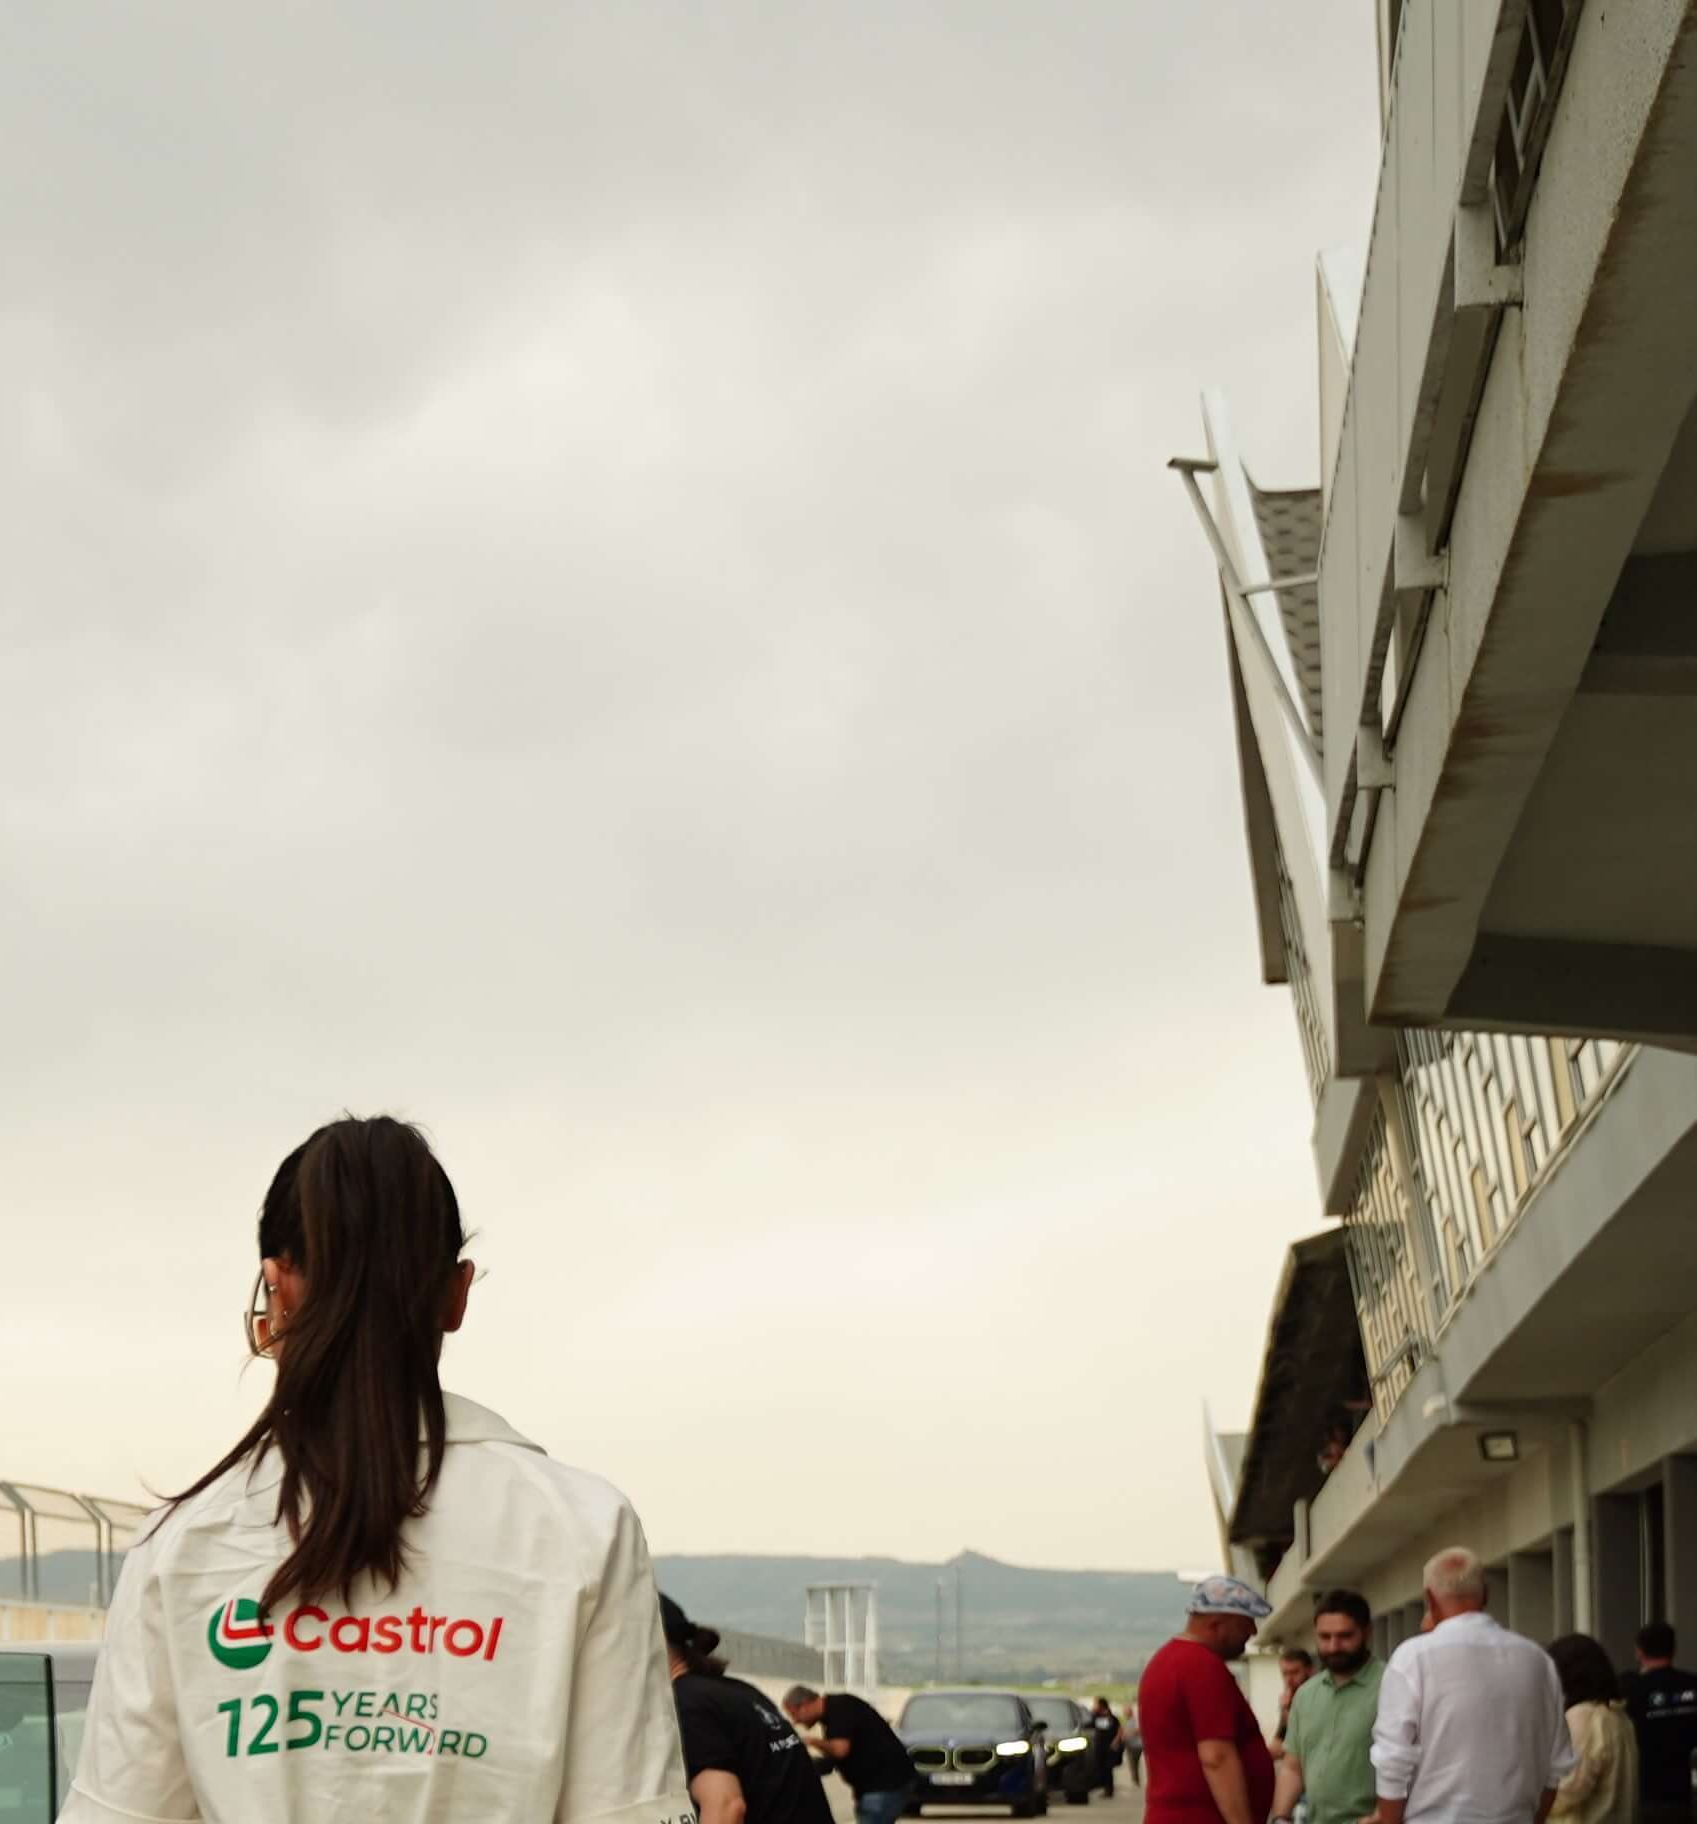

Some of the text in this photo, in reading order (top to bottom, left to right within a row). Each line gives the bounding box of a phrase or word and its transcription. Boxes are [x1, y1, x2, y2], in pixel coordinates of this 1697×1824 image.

[283, 1604, 504, 1662] Castrol
[216, 1690, 439, 1758] 125 YEARS
